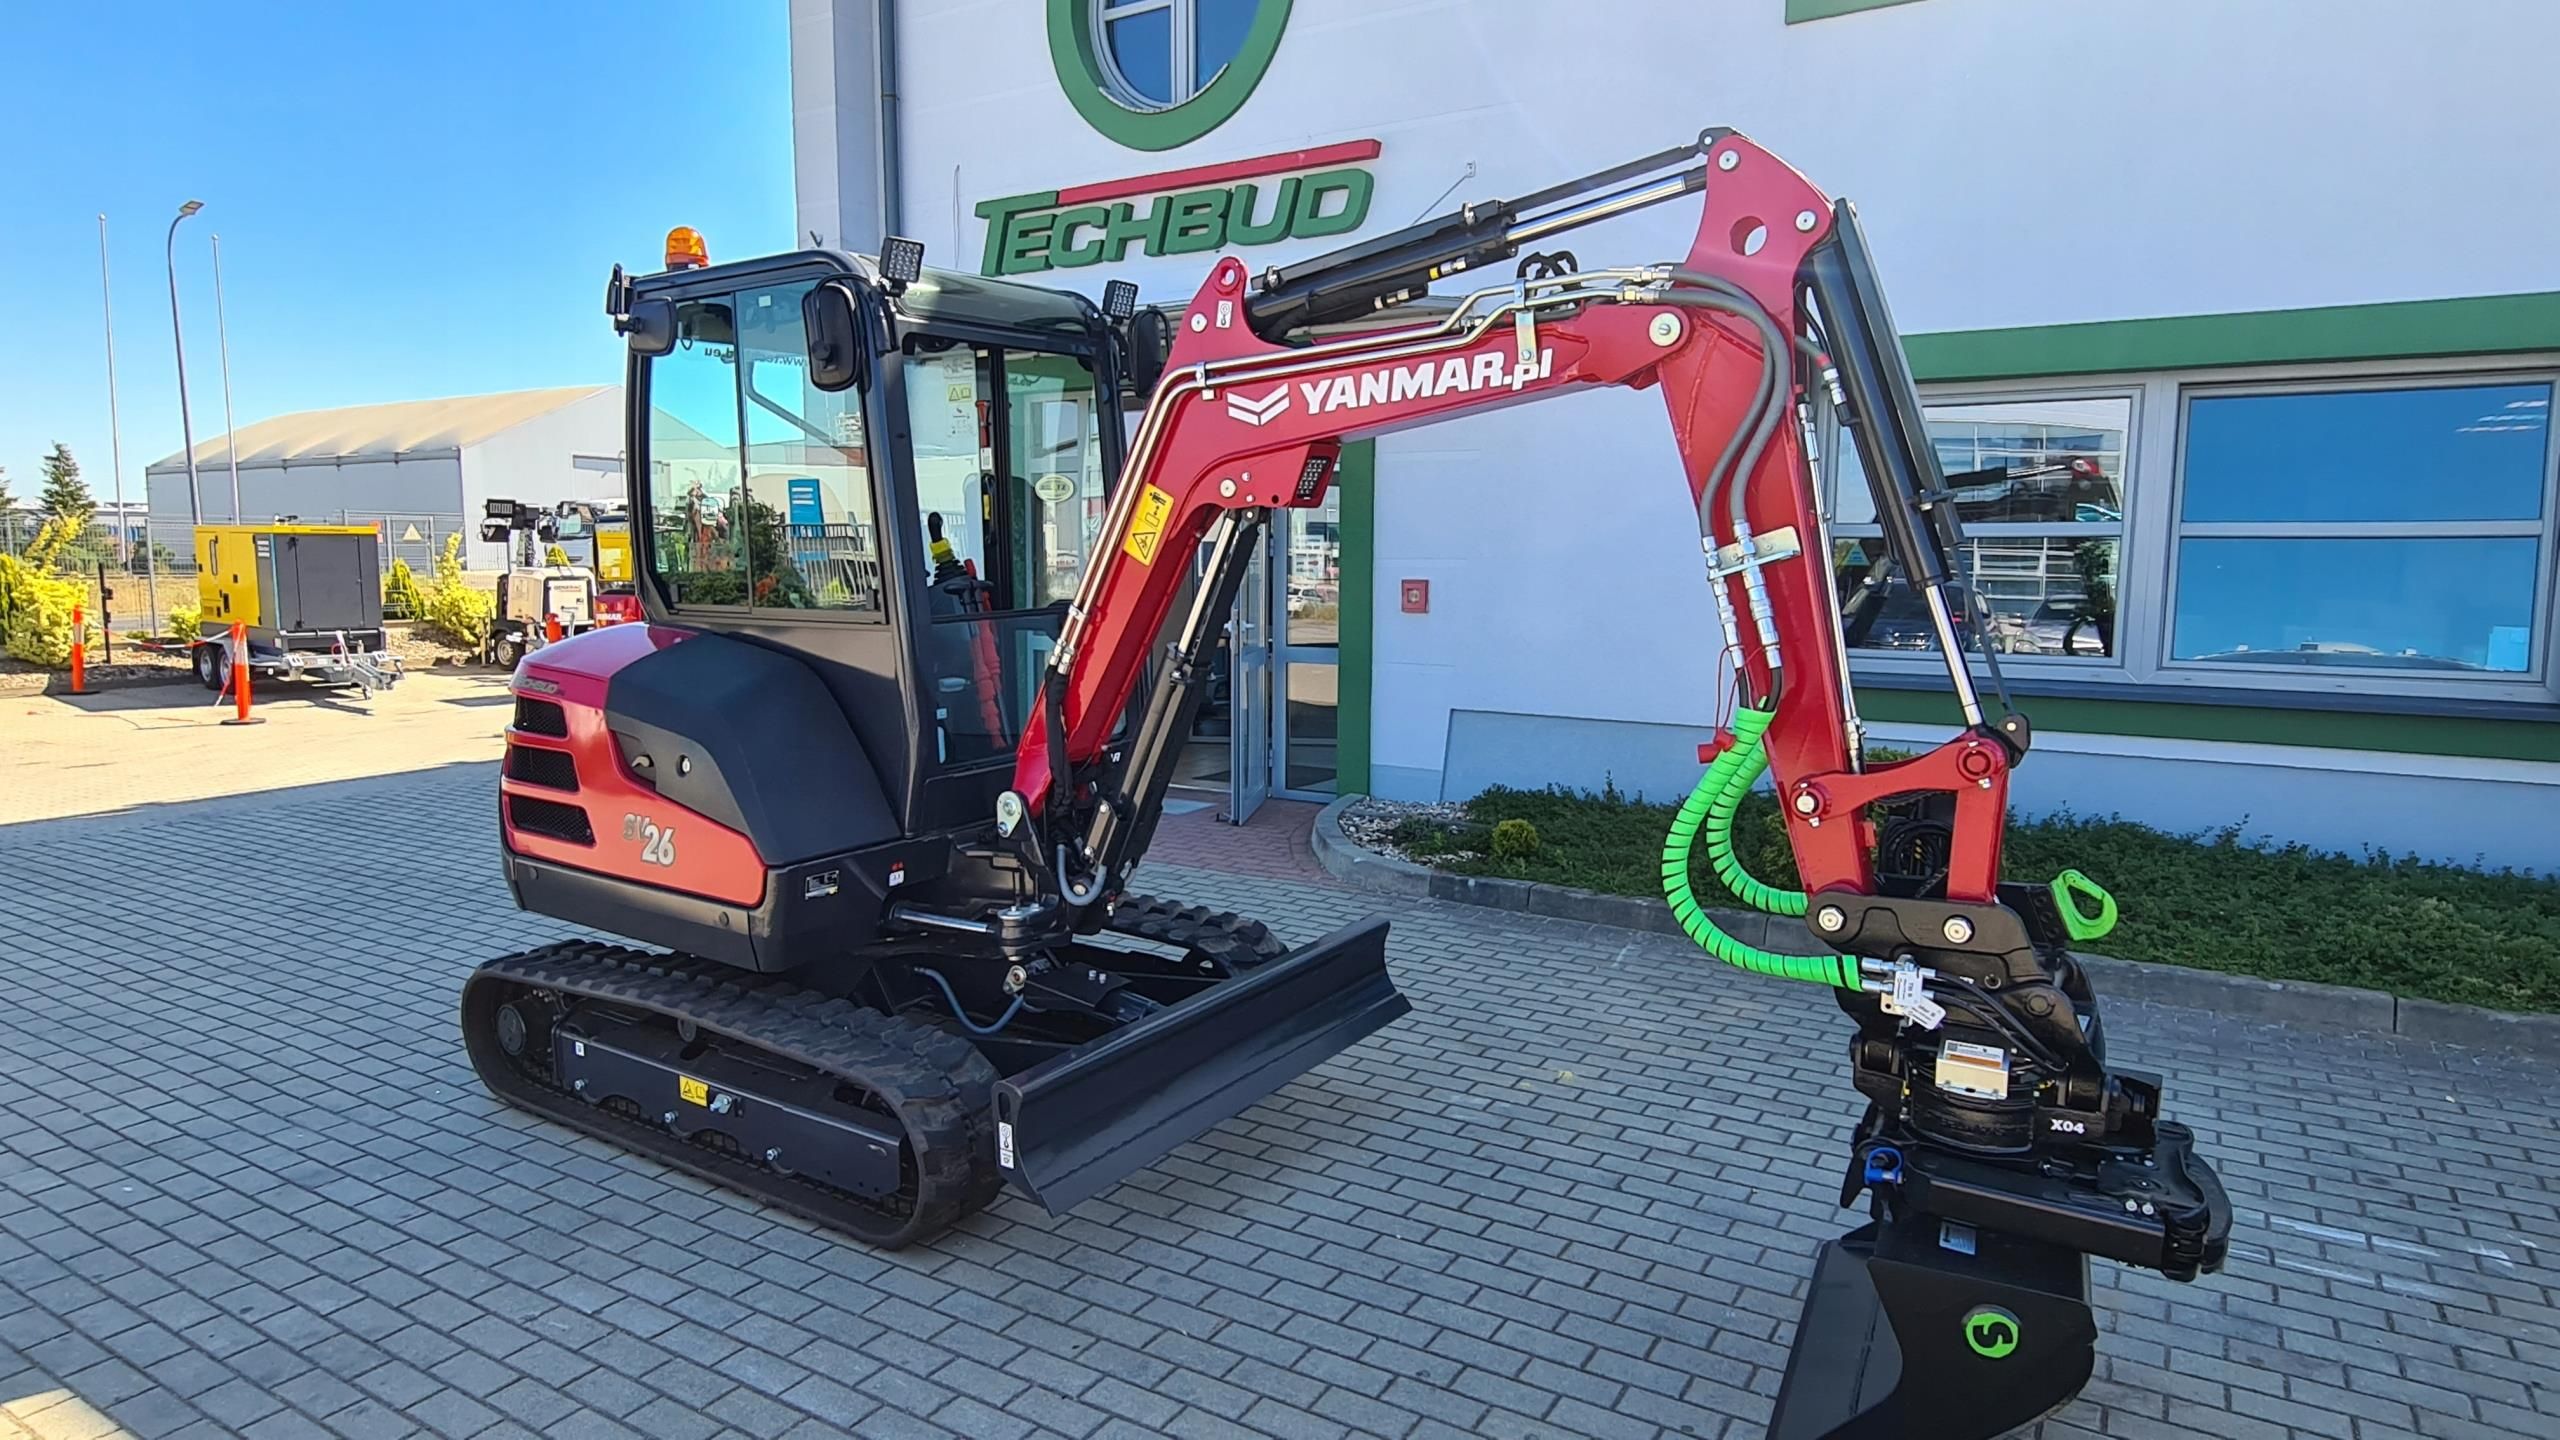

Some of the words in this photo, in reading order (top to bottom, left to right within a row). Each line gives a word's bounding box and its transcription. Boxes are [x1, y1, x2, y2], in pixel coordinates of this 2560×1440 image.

[975, 168, 1375, 277] TECHBUD
[1299, 348, 1553, 415] YANMAR.pl
[2050, 1118, 2085, 1135] X04
